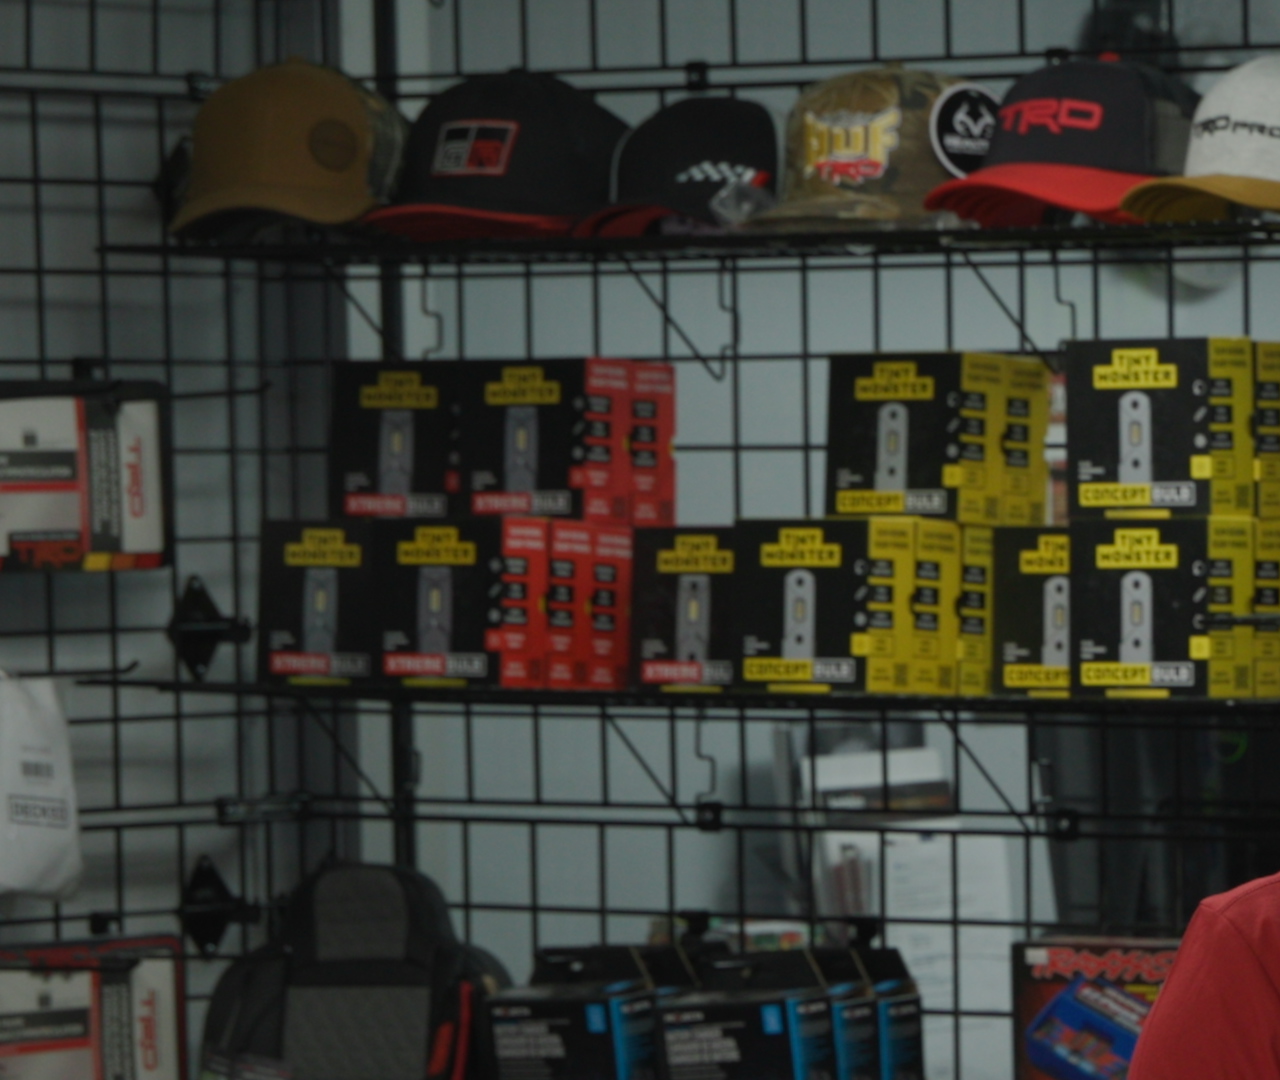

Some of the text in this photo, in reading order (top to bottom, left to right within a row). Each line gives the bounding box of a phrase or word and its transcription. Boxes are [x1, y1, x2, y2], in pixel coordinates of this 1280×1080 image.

[998, 97, 1103, 136] TRD
[1098, 370, 1172, 382] MONSTER
[859, 383, 928, 393] MONSTER
[1081, 486, 1147, 501] CONCEPT
[1044, 540, 1067, 551] TIN
[764, 550, 836, 561] MONSTER
[1100, 550, 1172, 561] MONSTER
[1023, 557, 1065, 568] MONS
[745, 661, 809, 676] CONCEPT
[1084, 666, 1147, 681] CONCEPT
